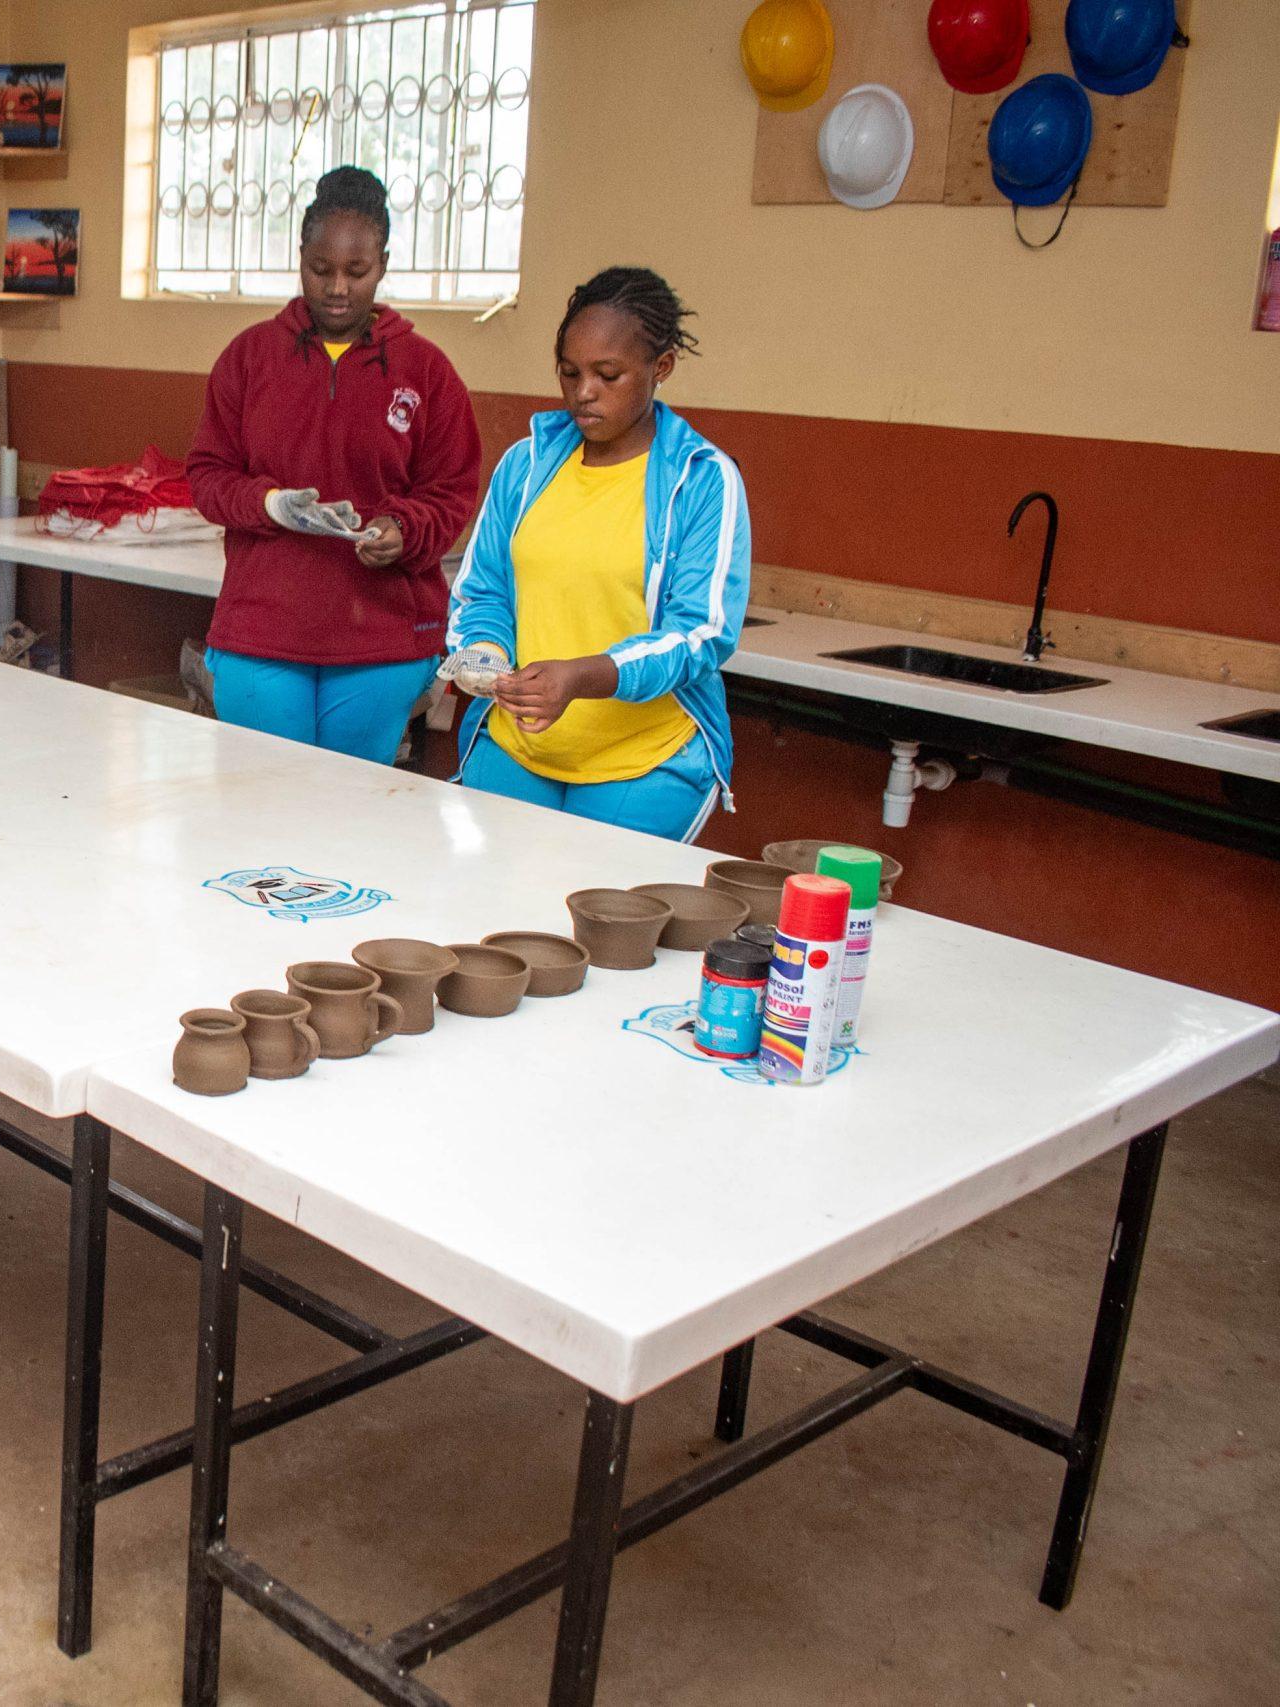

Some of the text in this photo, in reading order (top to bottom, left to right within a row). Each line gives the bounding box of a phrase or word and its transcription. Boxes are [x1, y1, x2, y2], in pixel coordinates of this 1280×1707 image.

[768, 976, 804, 995] erosol
[766, 995, 800, 1016] pray
[773, 989, 803, 1003] PAINT
